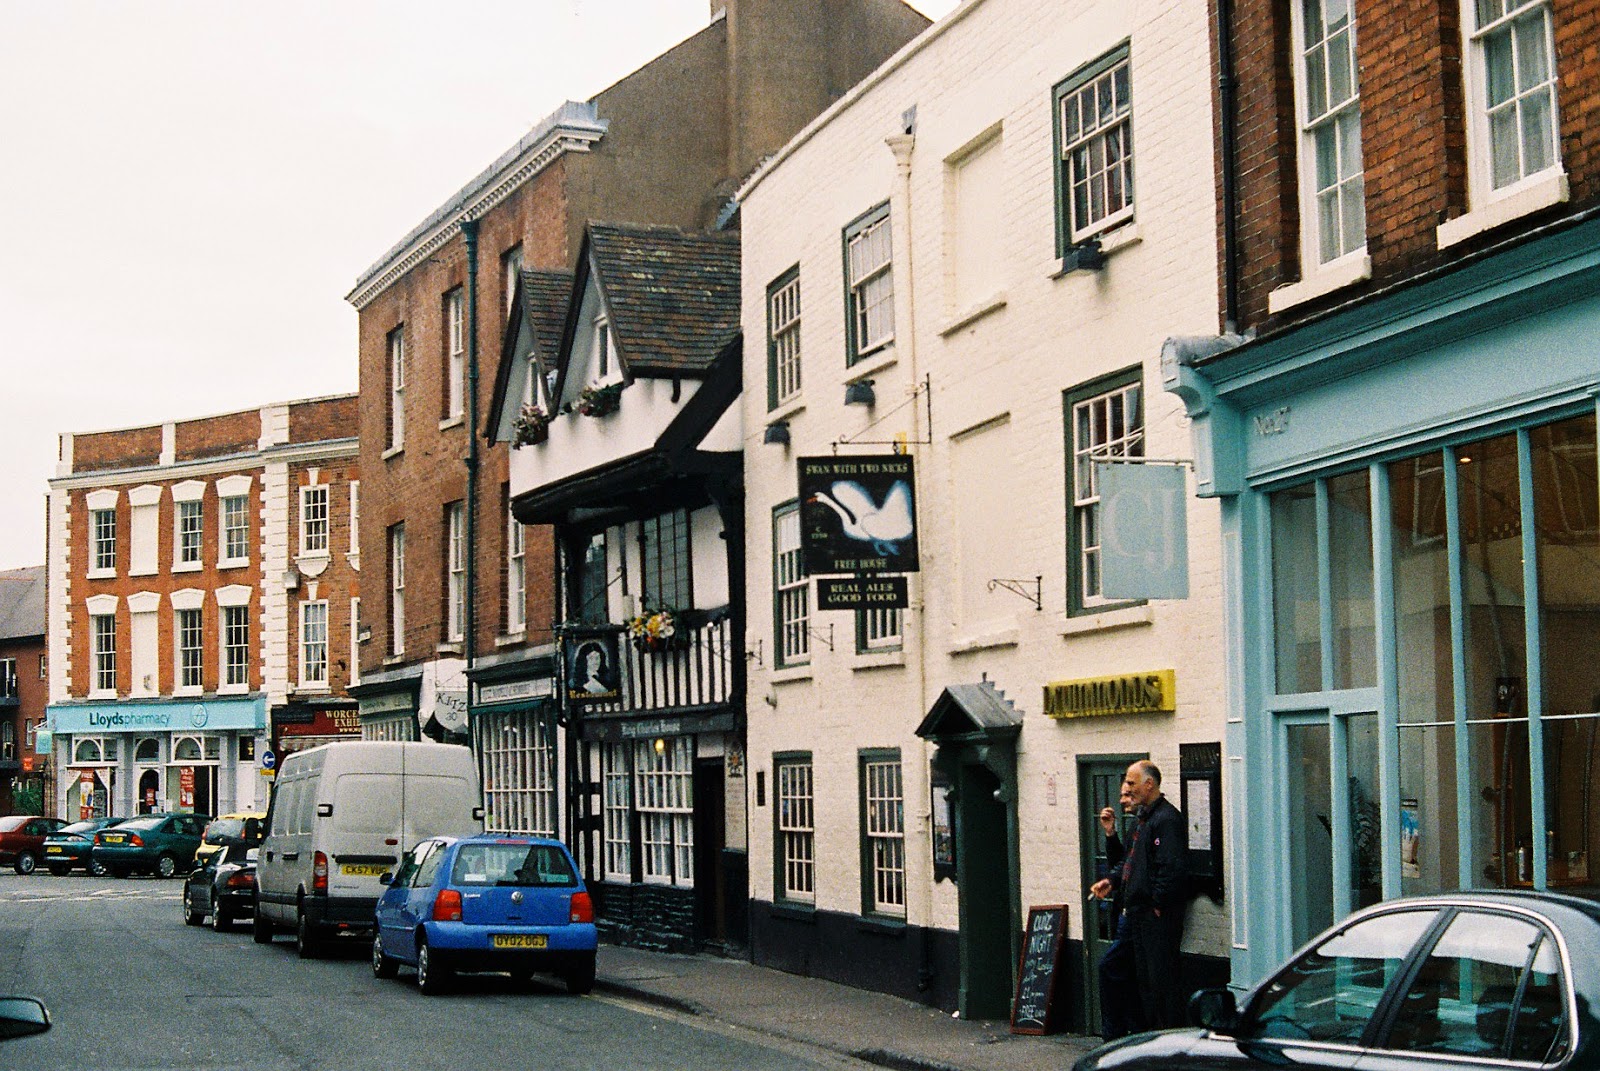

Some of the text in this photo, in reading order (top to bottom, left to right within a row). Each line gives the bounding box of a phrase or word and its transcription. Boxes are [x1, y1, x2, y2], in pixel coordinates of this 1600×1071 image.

[806, 465, 830, 474] SWAN
[833, 464, 857, 473] WITH
[860, 464, 879, 473] TWO
[834, 558, 887, 570] FREE HOUSE
[830, 583, 894, 593] REAL ALES
[828, 593, 897, 603] GOOD FOOD
[325, 709, 360, 719] WORCE
[89, 712, 171, 728] Lloydspharmacy
